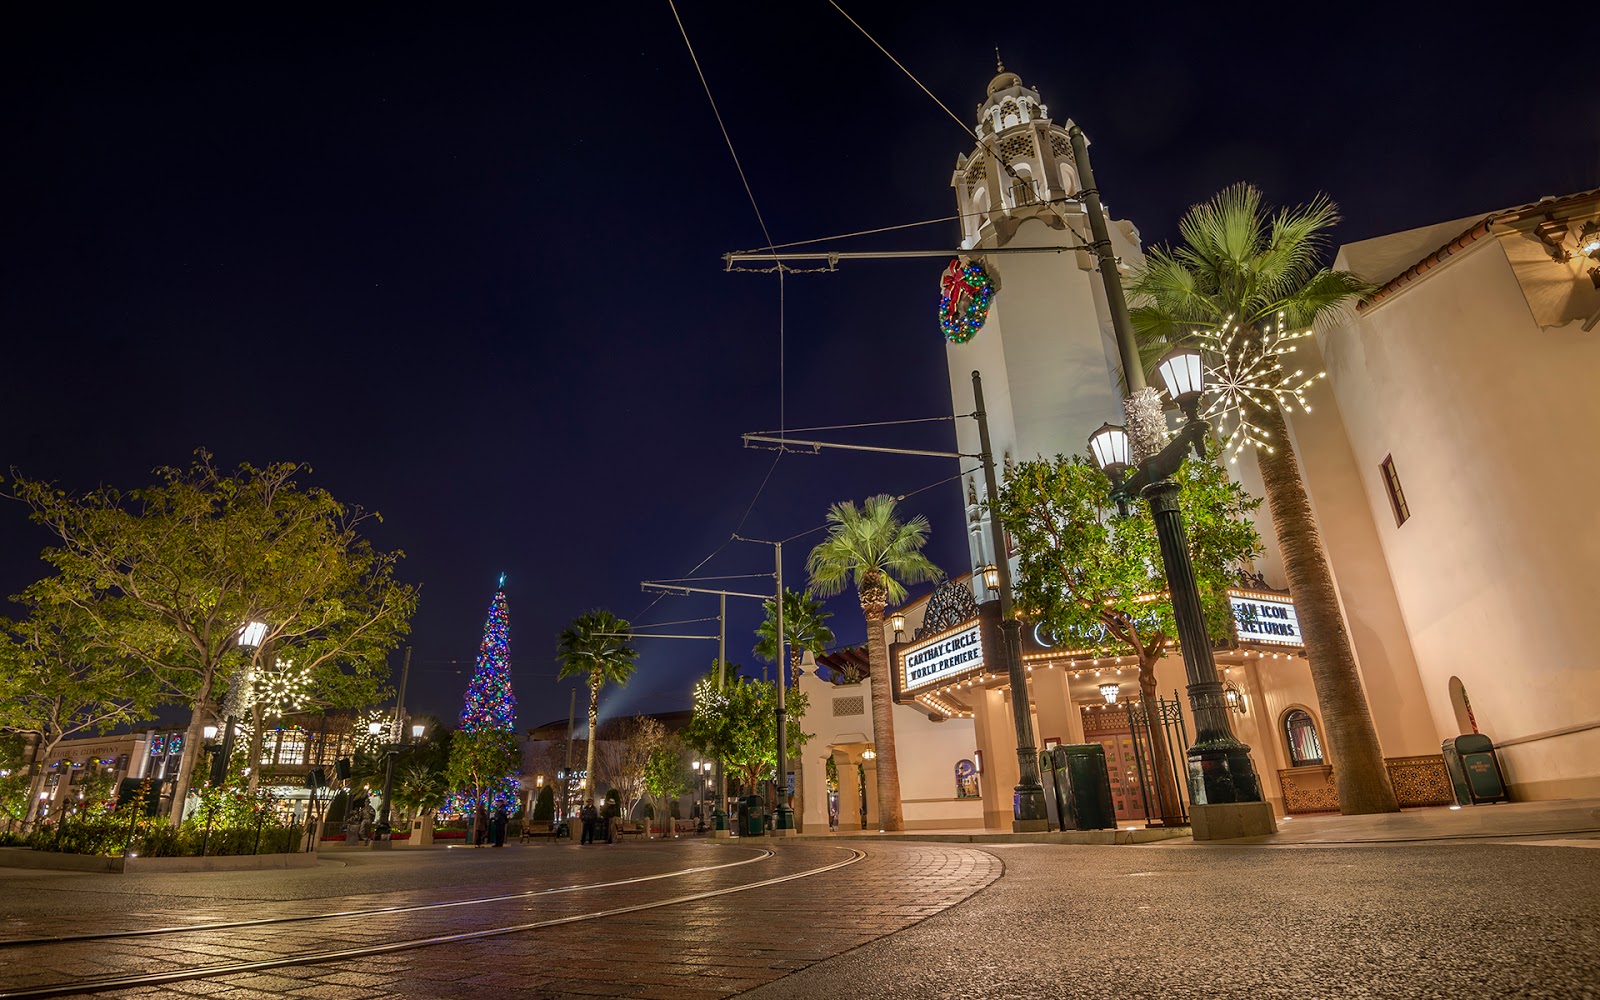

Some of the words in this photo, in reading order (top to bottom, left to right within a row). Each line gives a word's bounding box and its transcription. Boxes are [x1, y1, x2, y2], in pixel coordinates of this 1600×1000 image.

[1260, 604, 1288, 619] ICON
[1241, 620, 1294, 636] RETURNS
[908, 643, 943, 668] CARTHAY
[945, 631, 976, 654] CIRCLE
[910, 662, 937, 680] WORLD
[939, 647, 978, 670] PREMIERE
[81, 746, 119, 756] COMPANY
